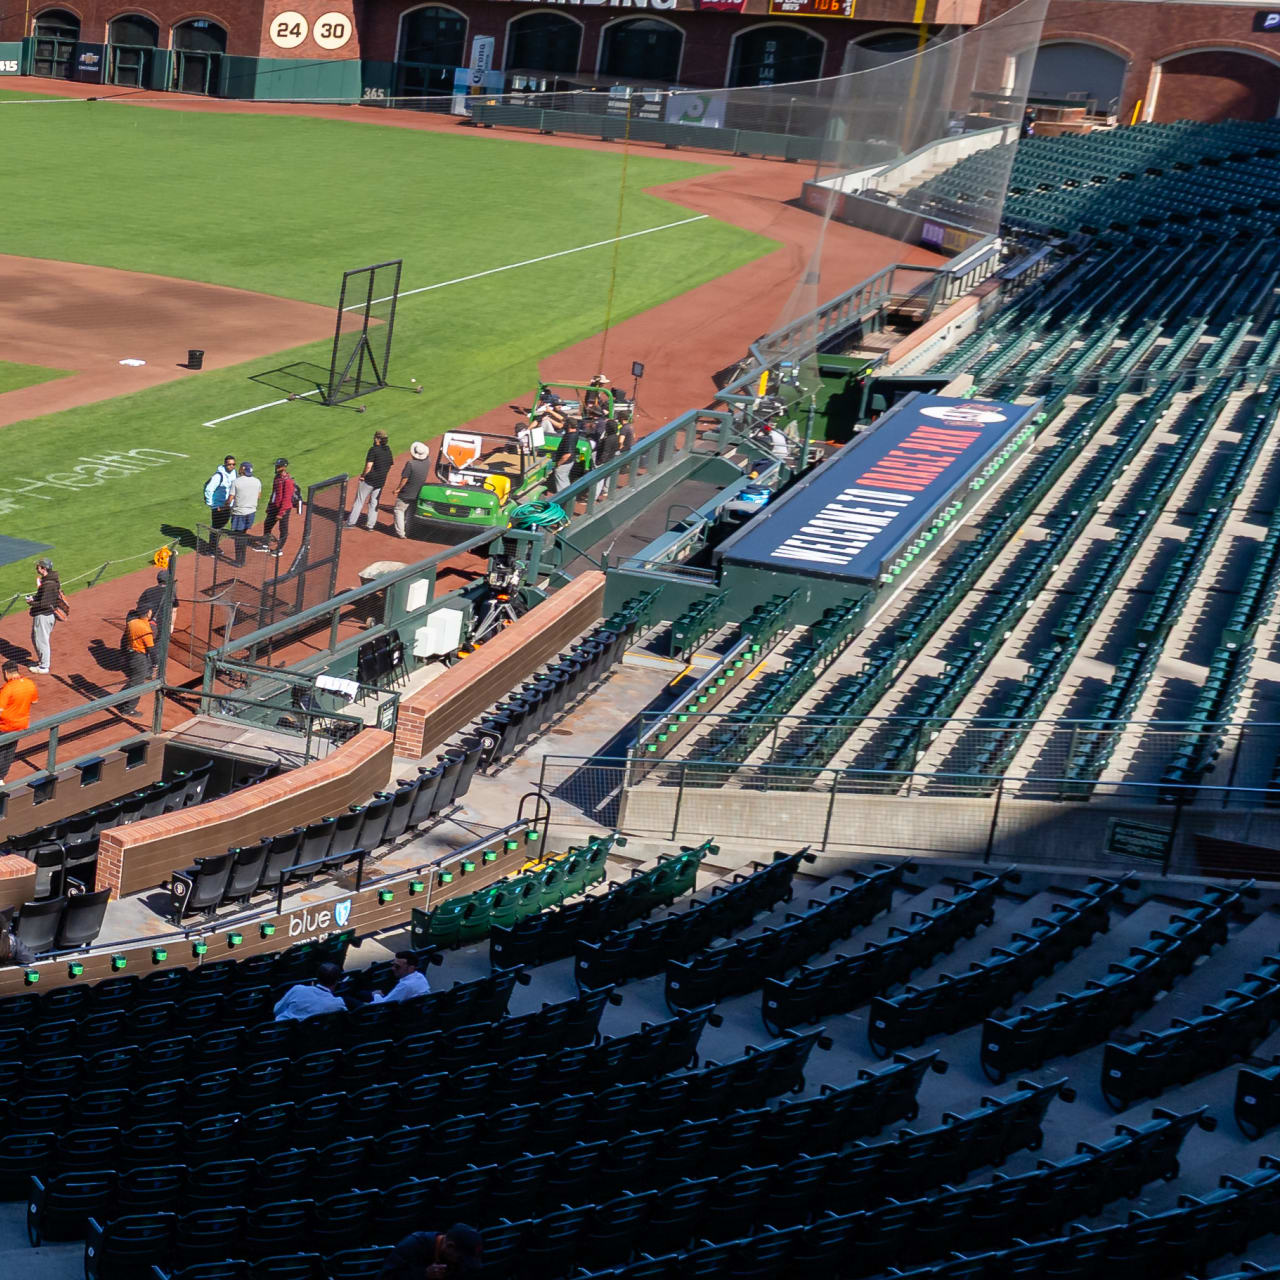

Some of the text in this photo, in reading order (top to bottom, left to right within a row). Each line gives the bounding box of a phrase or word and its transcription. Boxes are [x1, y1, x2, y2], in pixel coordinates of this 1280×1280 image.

[276, 22, 302, 38] 24
[320, 23, 345, 38] 30
[363, 87, 385, 99] 365
[770, 502, 900, 566] WELCOME
[289, 910, 332, 937] blue
